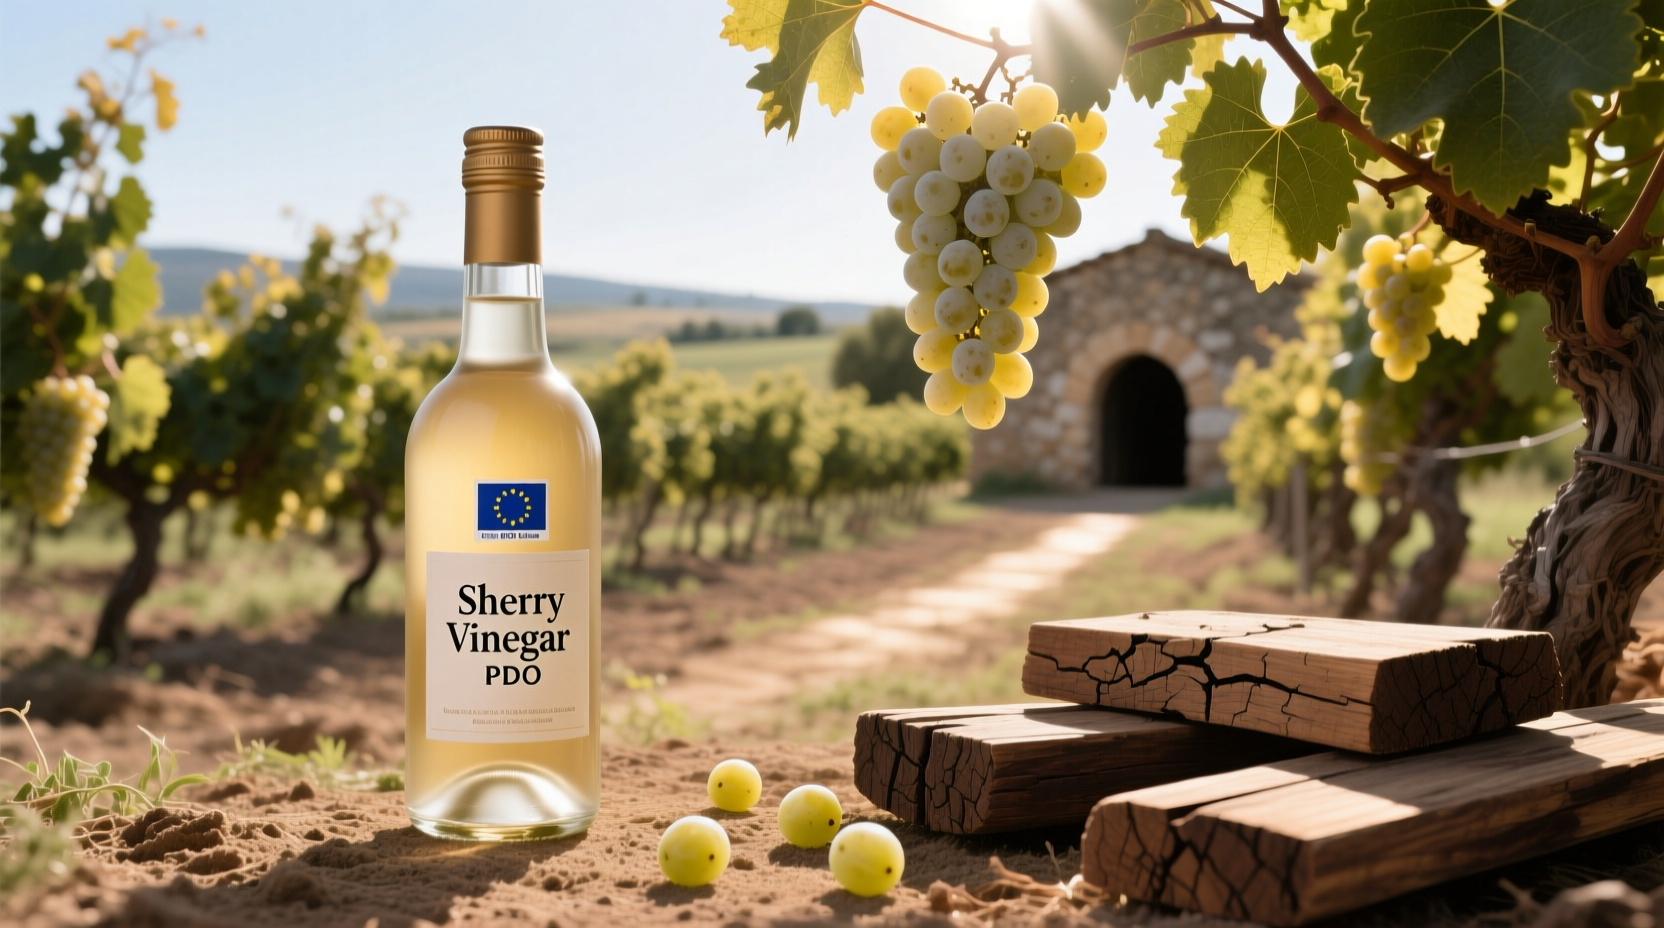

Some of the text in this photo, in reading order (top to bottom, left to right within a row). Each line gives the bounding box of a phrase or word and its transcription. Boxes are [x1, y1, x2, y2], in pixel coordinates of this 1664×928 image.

[458, 583, 565, 623] Sherry
[446, 622, 570, 662] Vinegar
[486, 665, 541, 685] PDO
